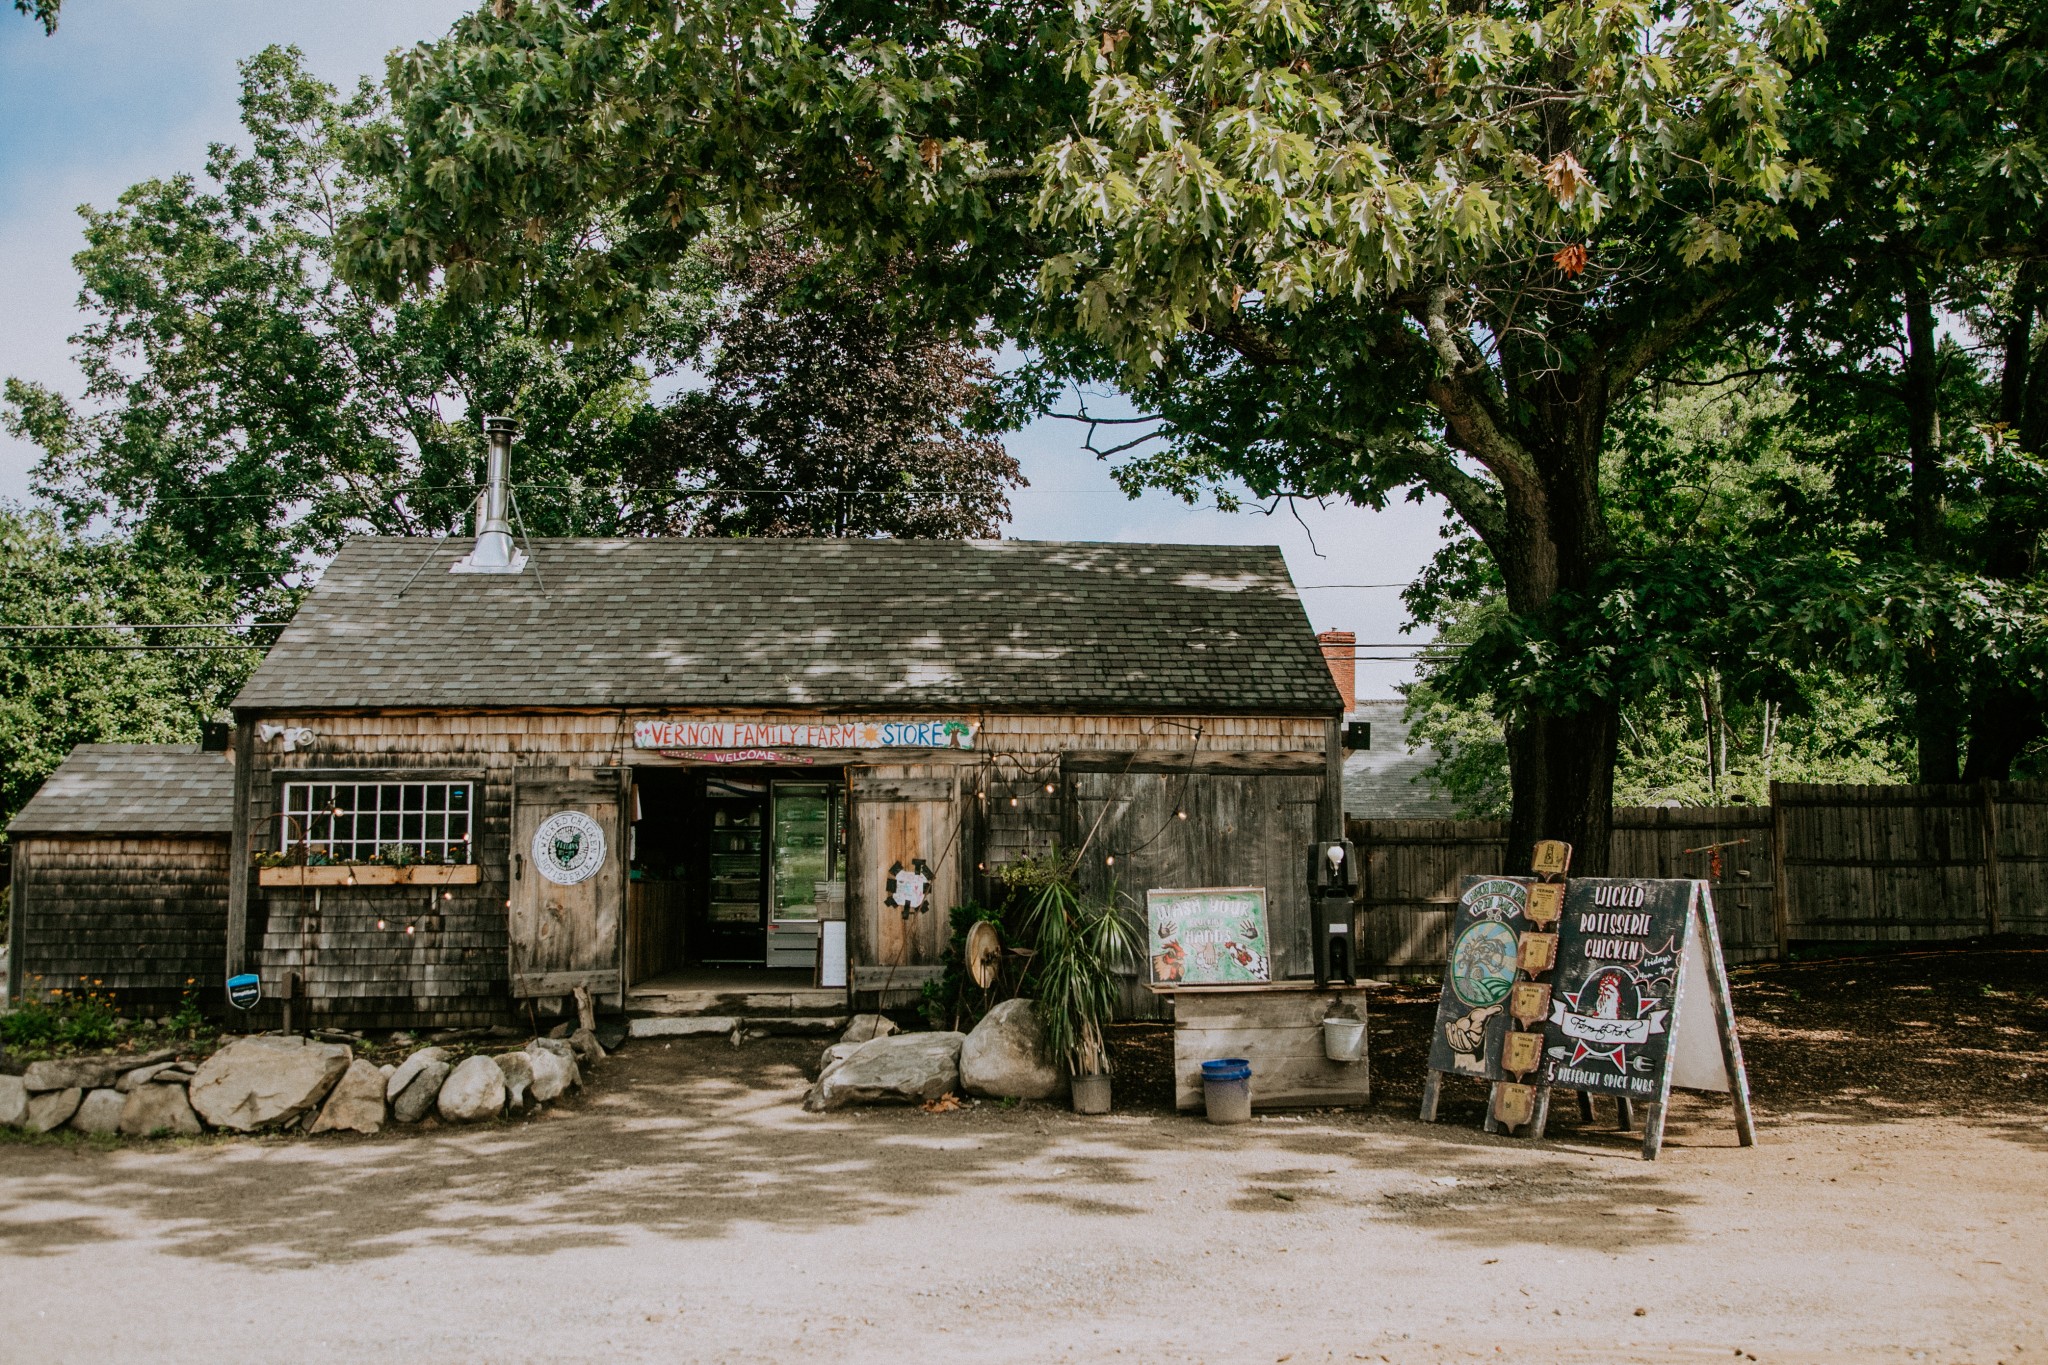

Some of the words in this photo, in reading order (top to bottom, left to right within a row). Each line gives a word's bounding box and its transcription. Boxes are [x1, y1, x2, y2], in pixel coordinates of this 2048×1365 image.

[651, 723, 724, 746] VERNON
[734, 723, 800, 745] FAMILY
[807, 724, 857, 745] FARM
[882, 723, 944, 746] STORE
[715, 751, 776, 763] WELCOME
[541, 817, 568, 848] WICKED
[571, 816, 598, 853] CHICKEN
[540, 858, 591, 881] ROTISSERIE
[1473, 896, 1494, 915] OPEN
[1594, 886, 1645, 908] WICKED
[1156, 899, 1202, 920] WASH
[1209, 898, 1250, 918] YOUR
[1579, 913, 1652, 936] ROTISSERIE
[1584, 938, 1640, 961] CHICKEN
[1644, 954, 1672, 967] Fridays
[1547, 1061, 1556, 1082] 5
[1557, 1068, 1600, 1085] DIFFERENT
[1603, 1073, 1629, 1089] SPICE
[1630, 1077, 1654, 1092] RUBS
